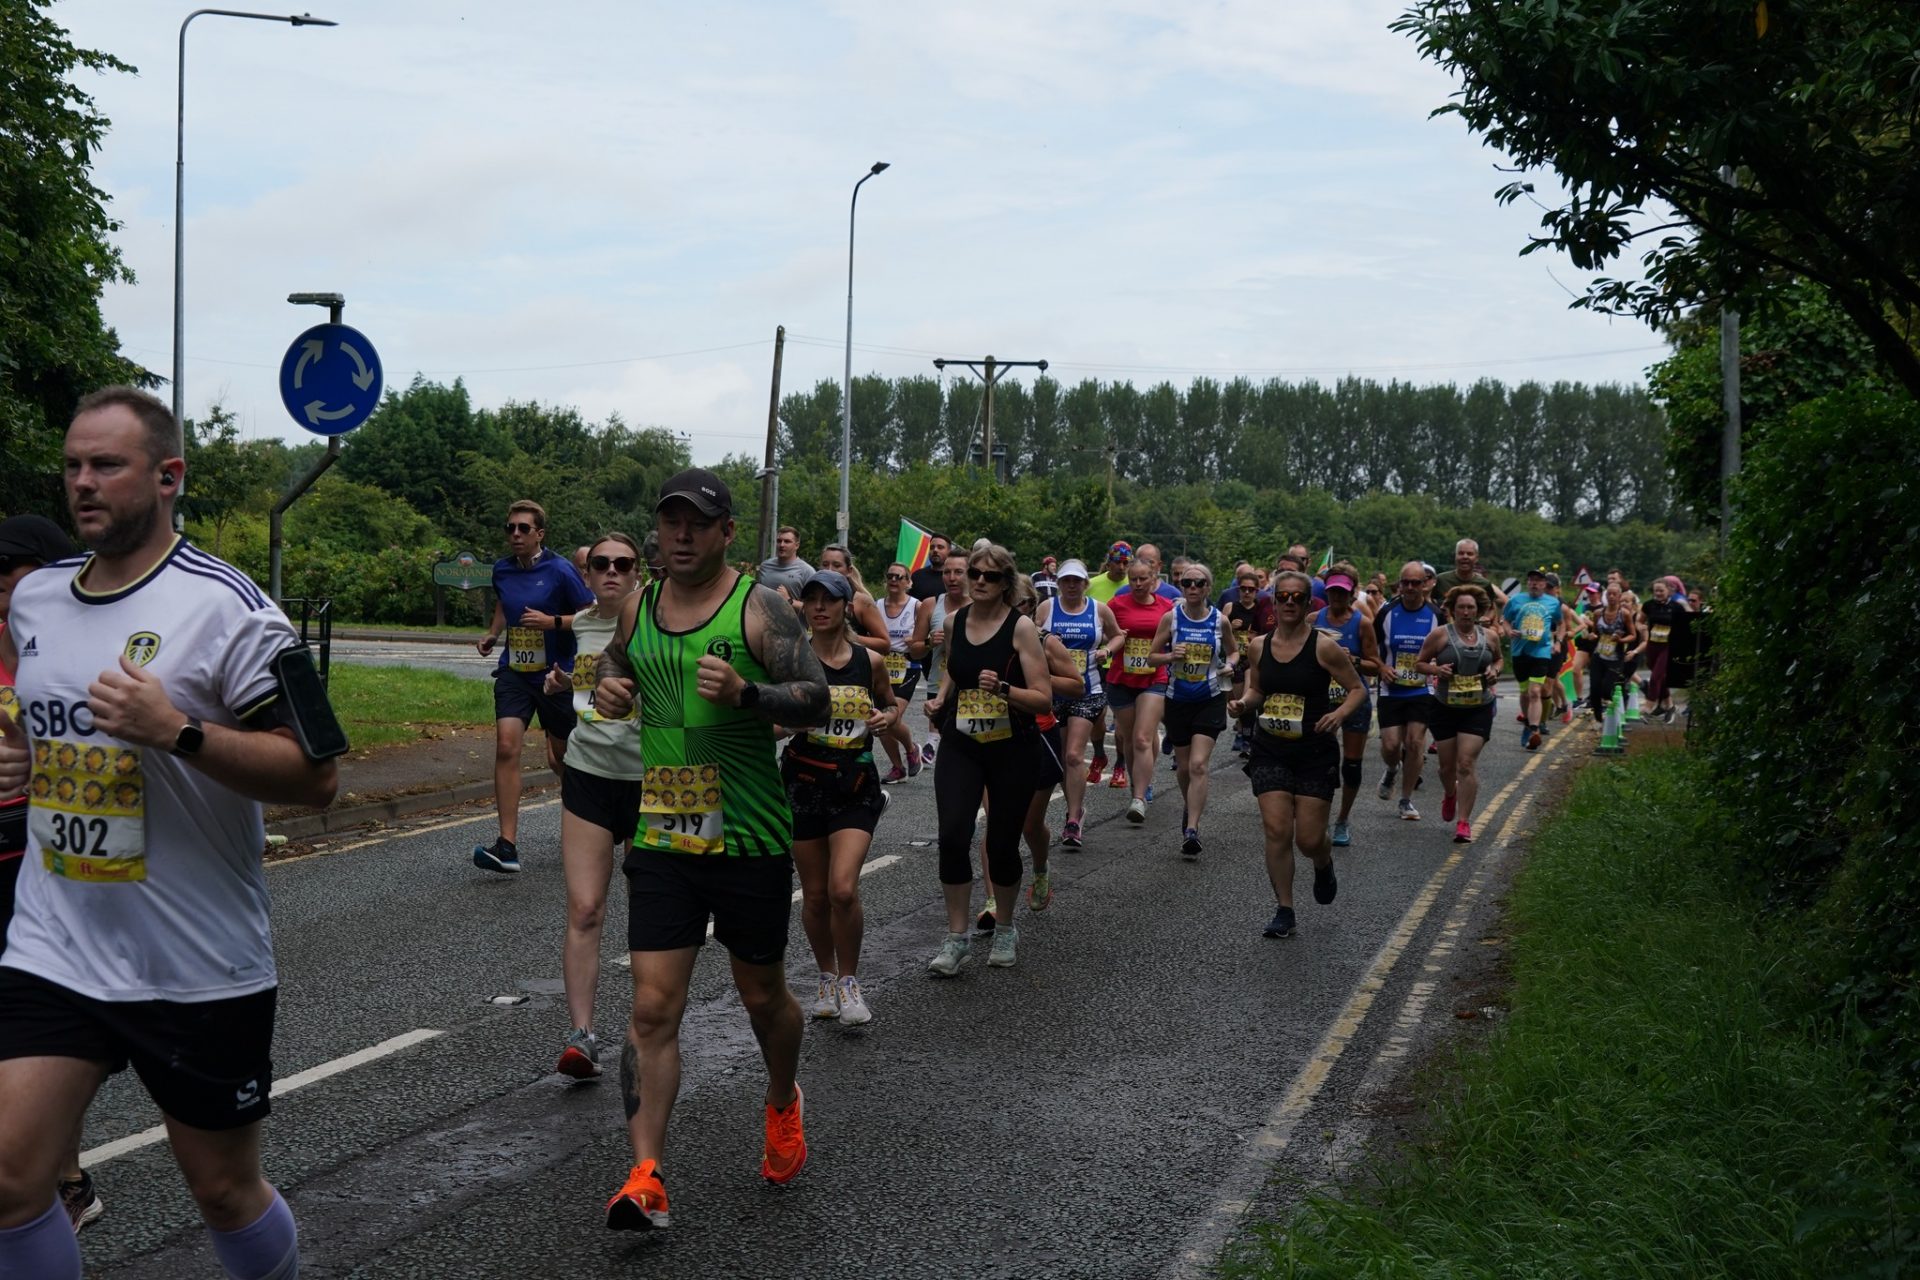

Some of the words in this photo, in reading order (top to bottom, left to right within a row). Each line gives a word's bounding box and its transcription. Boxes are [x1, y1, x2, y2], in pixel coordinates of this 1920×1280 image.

[516, 651, 535, 664] 502
[1130, 657, 1149, 667] 287
[1183, 663, 1200, 674] 607
[825, 718, 854, 737] 189
[968, 719, 995, 733] 219
[1268, 718, 1291, 731] 338
[662, 813, 703, 835] 519
[51, 813, 108, 857] 302
